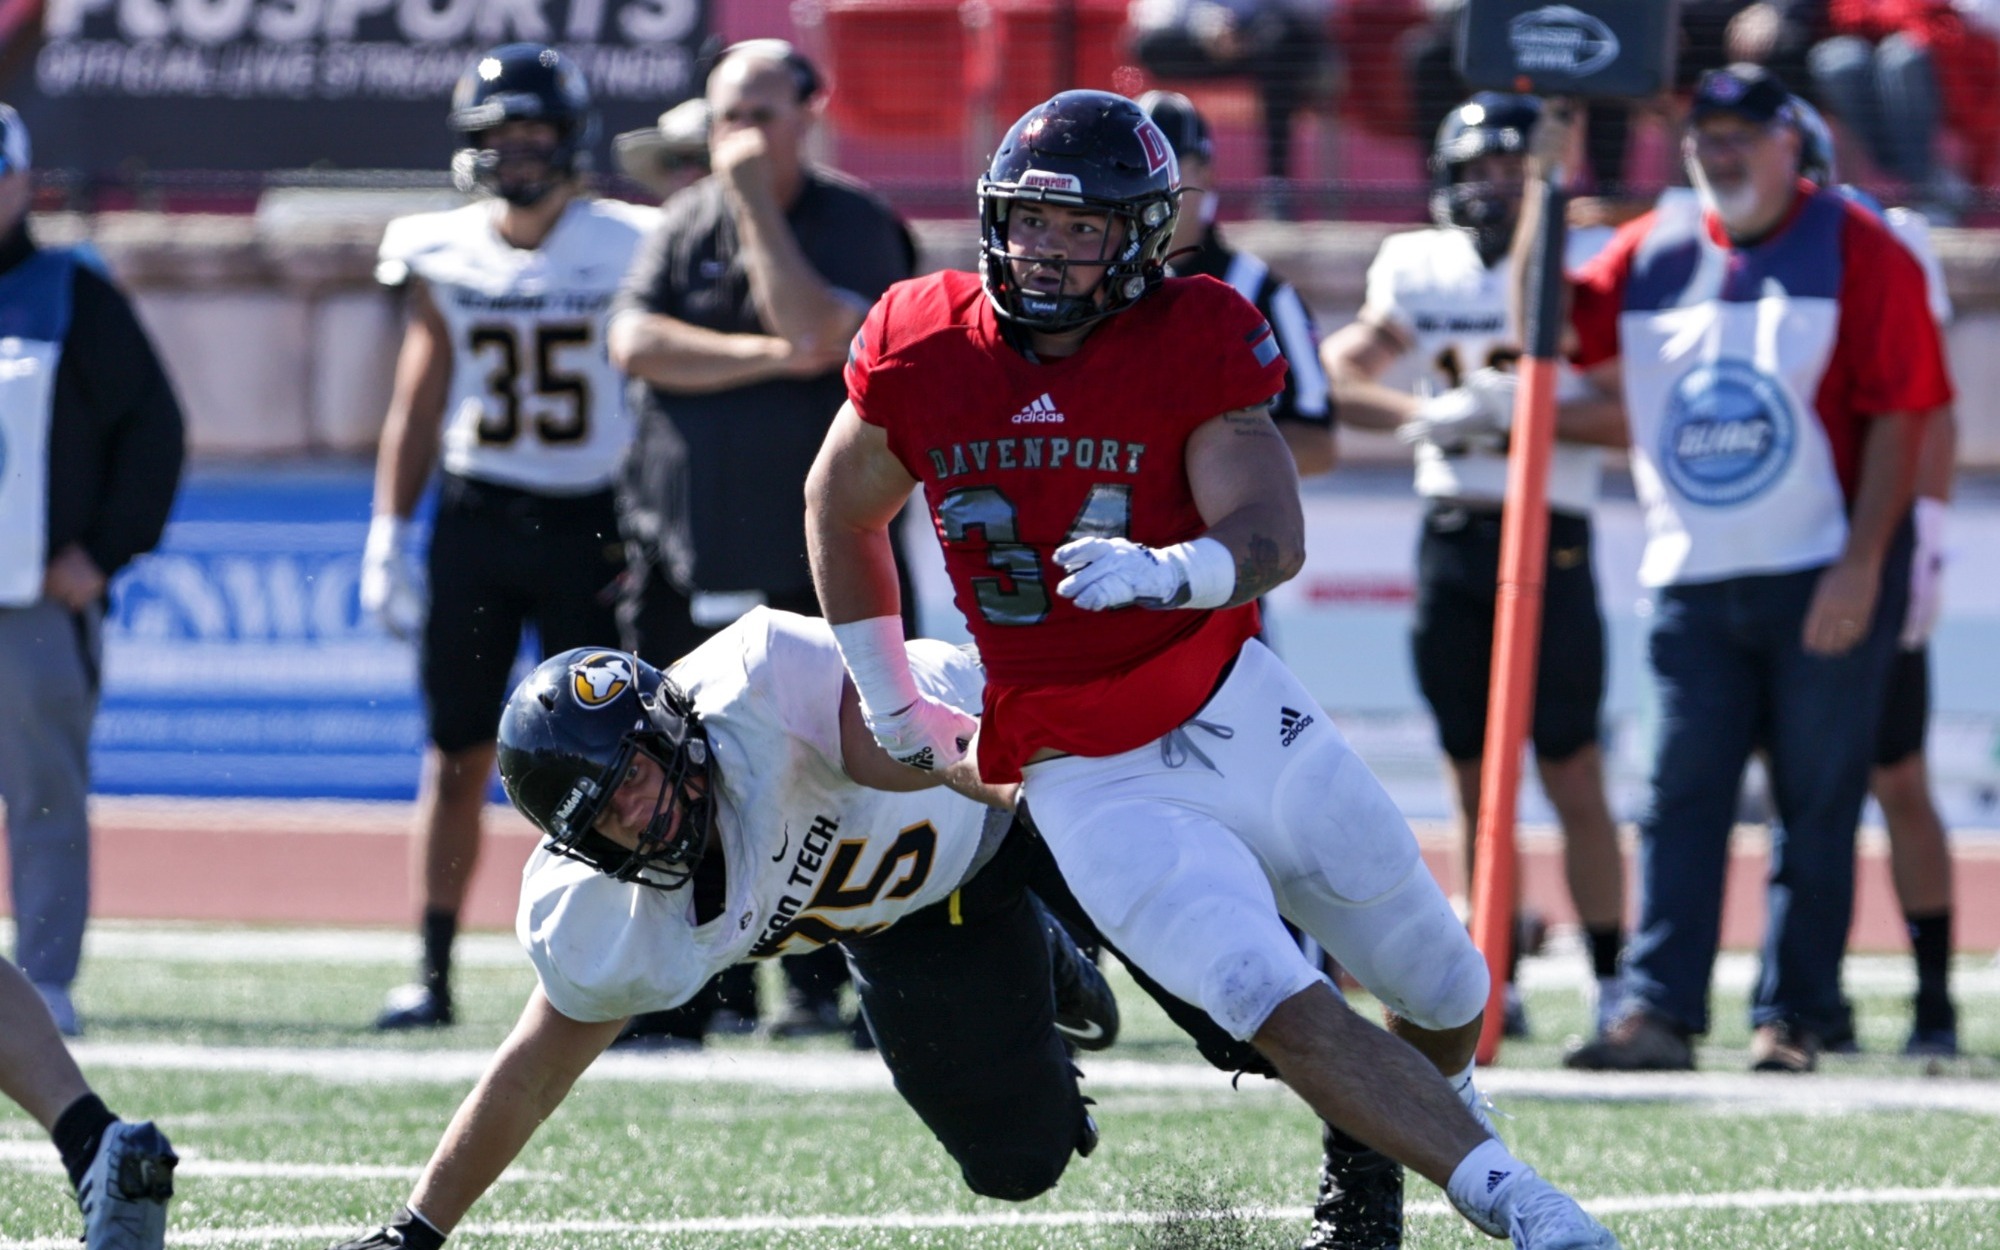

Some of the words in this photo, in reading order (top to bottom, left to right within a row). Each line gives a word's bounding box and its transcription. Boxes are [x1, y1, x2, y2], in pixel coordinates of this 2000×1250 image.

[468, 322, 592, 448] 35
[1011, 410, 1065, 424] adidas
[927, 437, 1146, 480] DAVENPORT
[1281, 714, 1315, 747] adidas
[787, 815, 840, 888] TECH
